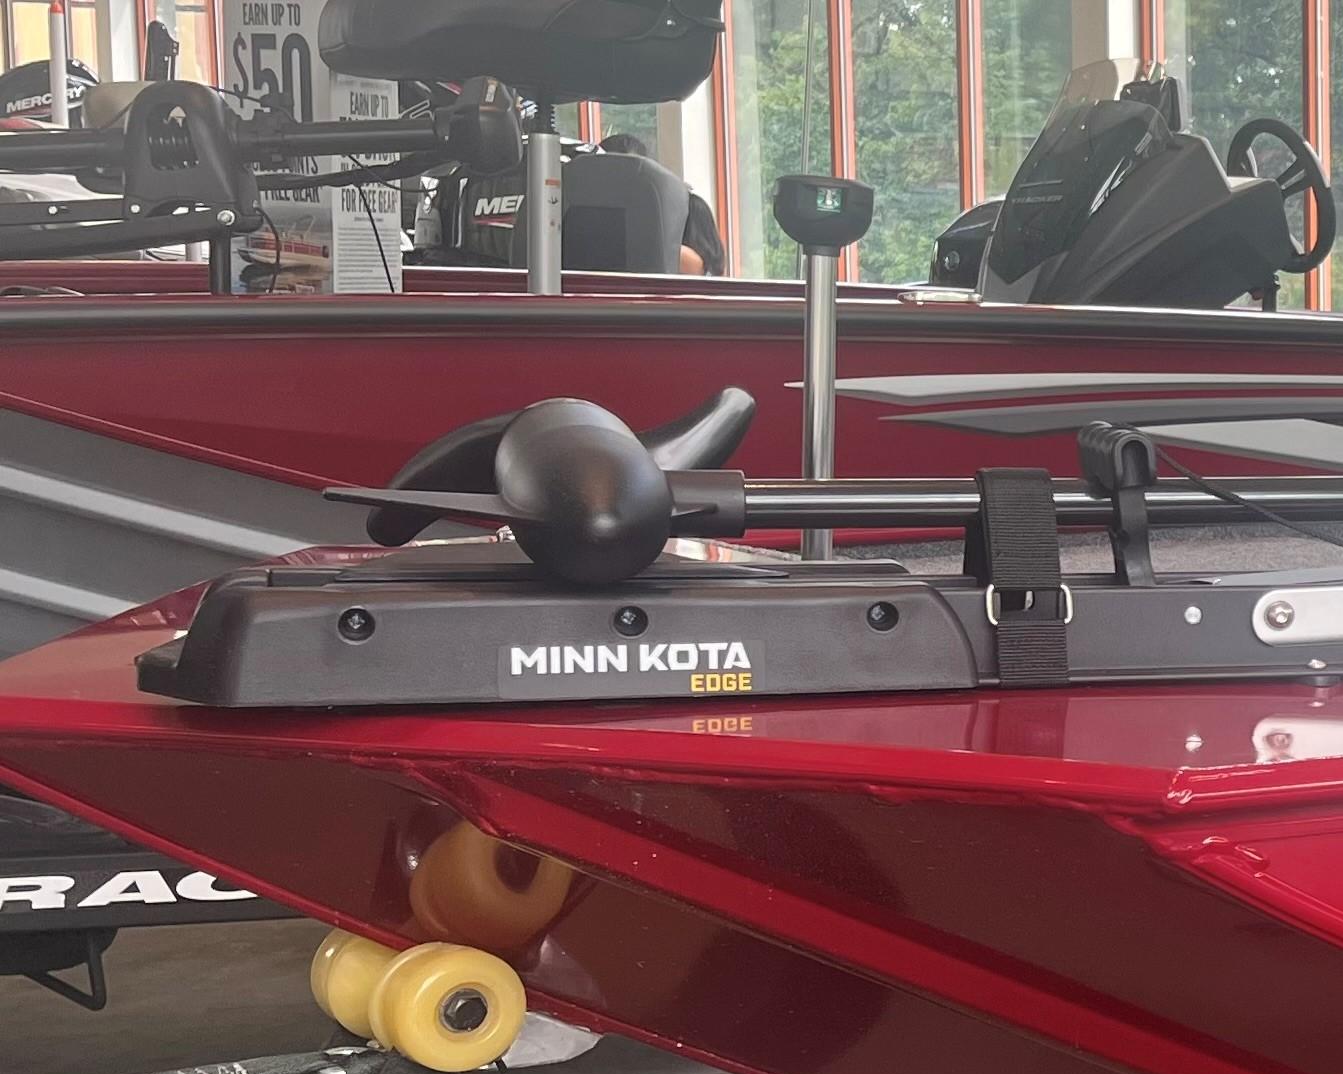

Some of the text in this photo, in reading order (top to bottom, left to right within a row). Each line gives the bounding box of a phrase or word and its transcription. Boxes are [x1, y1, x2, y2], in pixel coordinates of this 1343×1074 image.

[242, 3, 301, 26] EARN UP TO
[6, 85, 86, 114] MERCRY
[341, 188, 357, 212] FOR
[510, 641, 752, 675] MINN KOTA
[690, 672, 753, 692] EDGE
